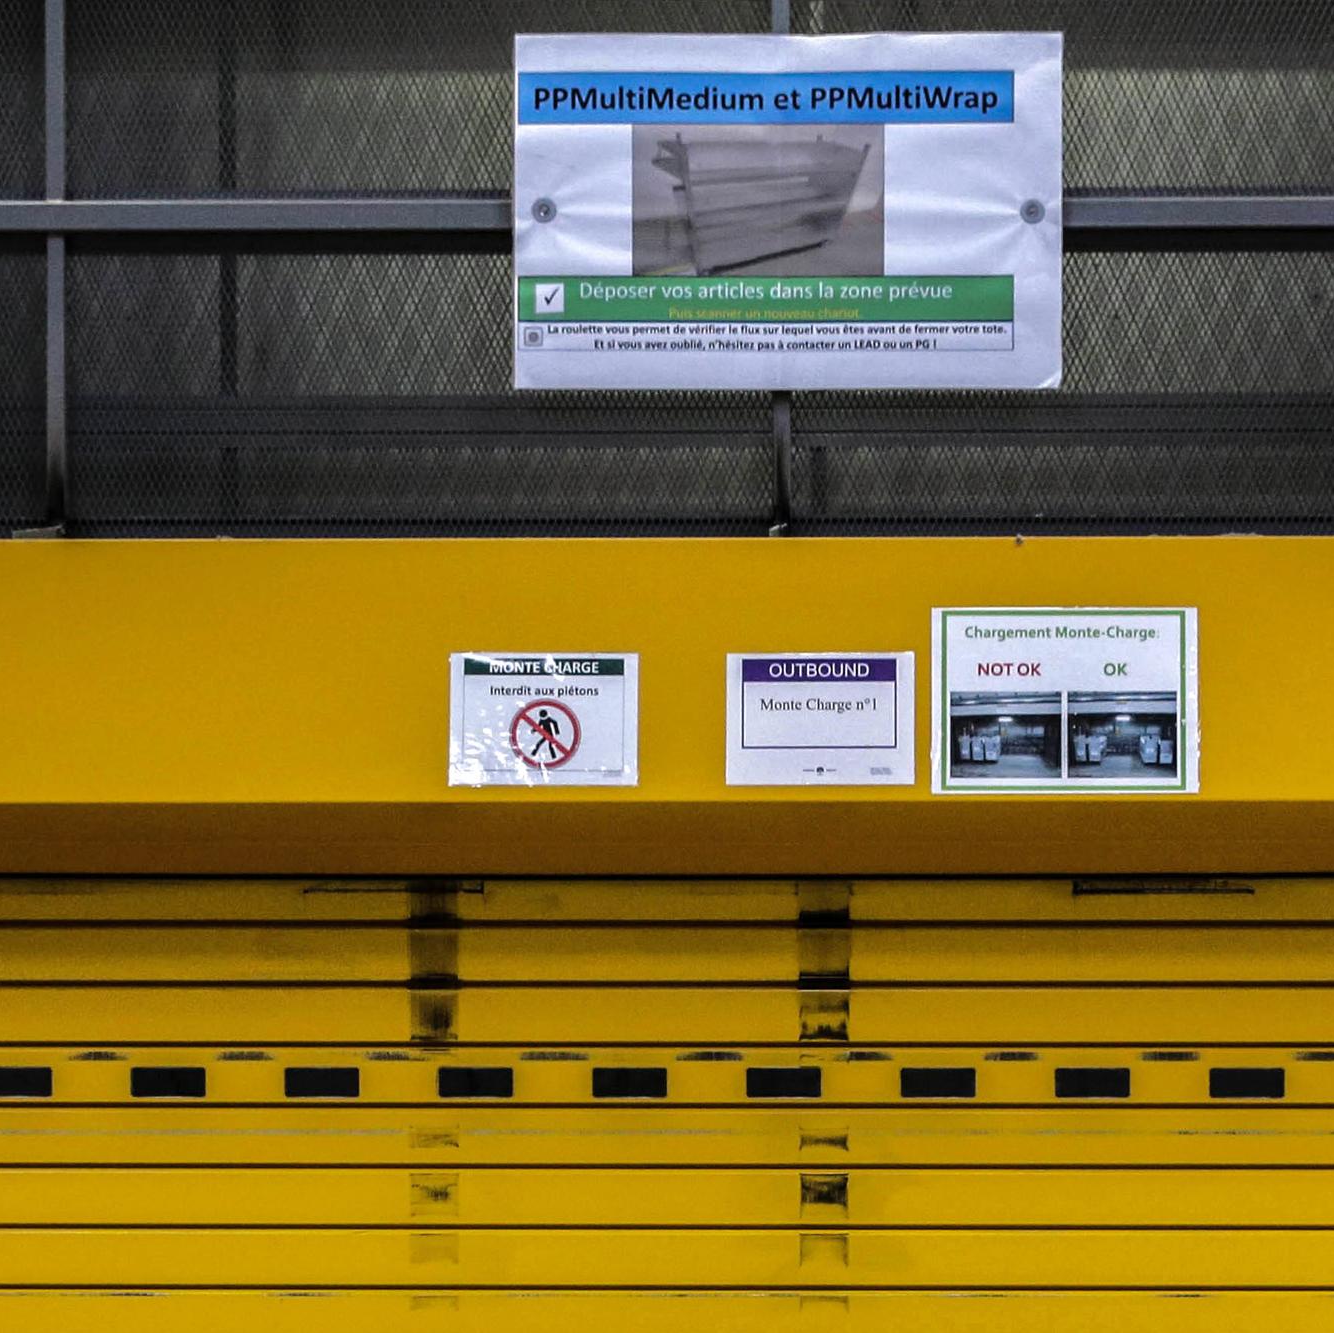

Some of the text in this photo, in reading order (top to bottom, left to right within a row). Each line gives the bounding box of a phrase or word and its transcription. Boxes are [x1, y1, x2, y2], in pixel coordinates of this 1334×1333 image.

[533, 85, 999, 114] PPMultiMedium et PPMultiWrap
[579, 281, 954, 302] Déposer vos articles dans la zone prévue
[668, 308, 693, 319] Puis
[763, 309, 816, 319] nouveau
[546, 325, 1008, 337] La roulette vous permet de vérifier le flux sur lequel vous êtes avant de fermer votre tote.
[593, 339, 605, 349] Et
[607, 340, 616, 349] si
[618, 341, 643, 350] vous
[645, 341, 668, 350] avez
[670, 339, 707, 351] oublié,
[757, 341, 776, 352] pas
[777, 339, 785, 350] à
[786, 340, 836, 350] contacter
[838, 341, 852, 350] un
[854, 339, 881, 350] LEAD
[883, 341, 898, 350] ou
[899, 341, 913, 350] un
[915, 339, 931, 350] PG
[964, 626, 1052, 642] Chargement
[488, 661, 600, 675] MONTE CHARGE
[768, 662, 871, 679] OUTBOUND
[977, 662, 1042, 677] NOT OK
[1103, 662, 1128, 677] OK
[489, 685, 600, 698] Interdit aux piétons
[760, 697, 878, 713] Monte Charge n°1
